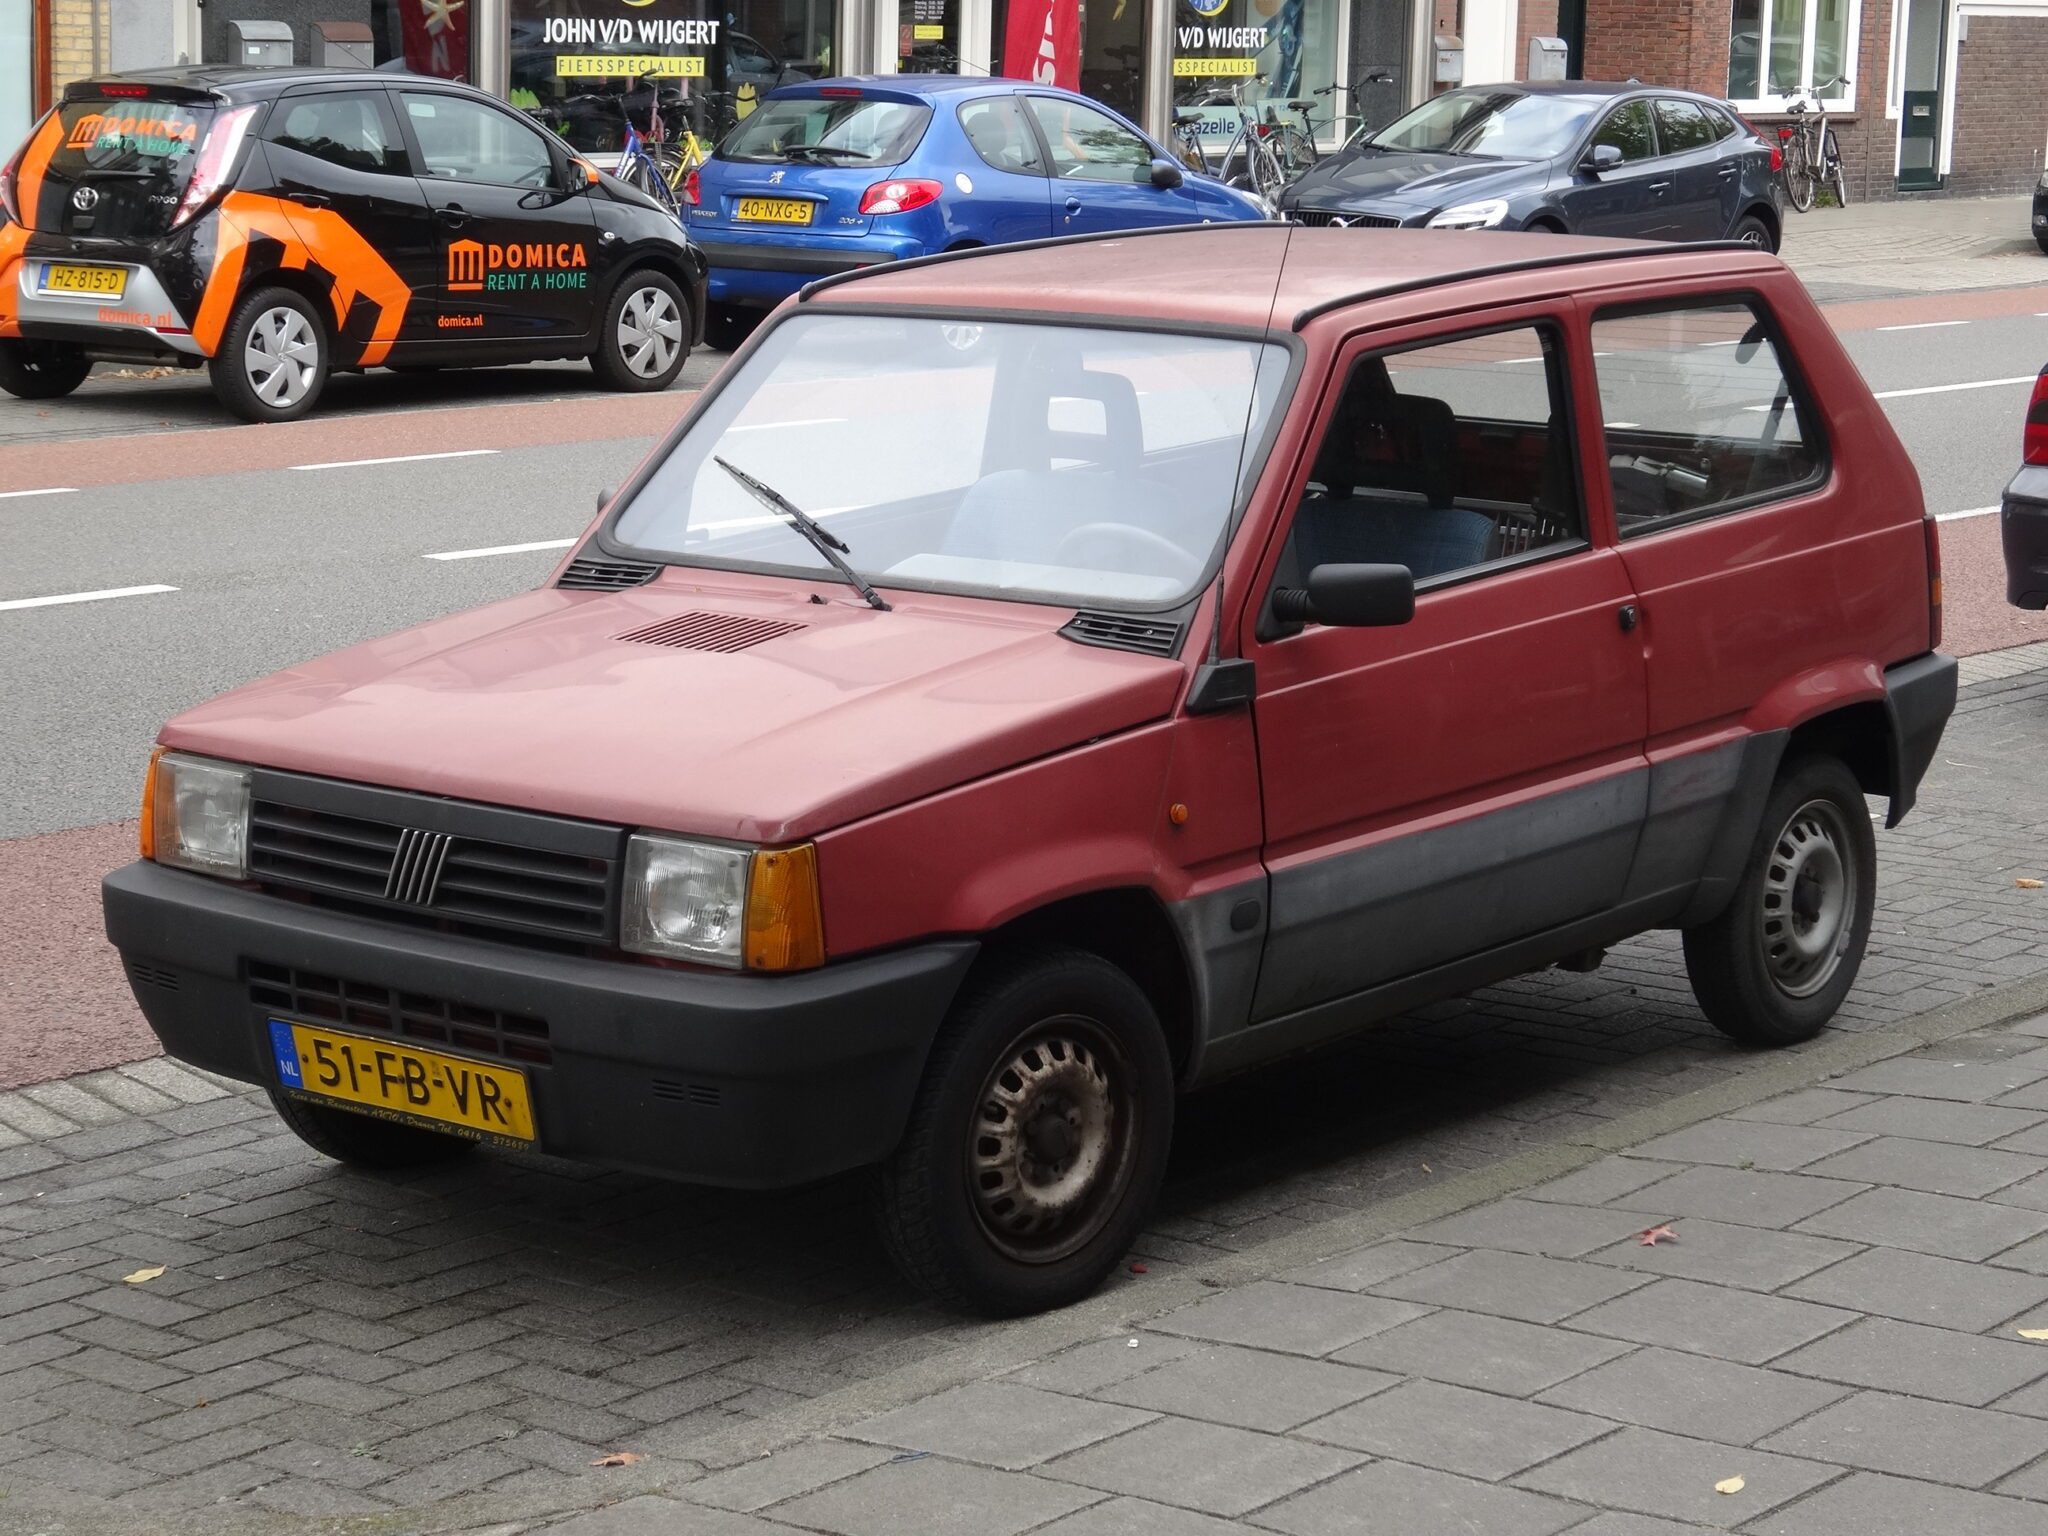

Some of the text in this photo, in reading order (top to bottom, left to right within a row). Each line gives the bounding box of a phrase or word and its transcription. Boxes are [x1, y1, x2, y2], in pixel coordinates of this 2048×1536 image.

[543, 18, 720, 45] JOHN V/D WIJGERT
[1178, 26, 1204, 49] V/D
[1207, 27, 1267, 48] WIJGERT
[558, 59, 703, 73] FIETSSPECIALIST
[102, 116, 197, 141] DOMICA
[97, 137, 191, 156] RENT A HOME
[741, 200, 807, 219] 40-NXG-5
[488, 243, 587, 268] DOMICA
[53, 269, 119, 290] HZ-815-D
[487, 272, 587, 290] RENT A HOME
[97, 308, 172, 327] domica.nl
[438, 314, 483, 327] domica.nl
[280, 1060, 299, 1077] NL
[312, 1038, 508, 1126] 51-FB-VR
